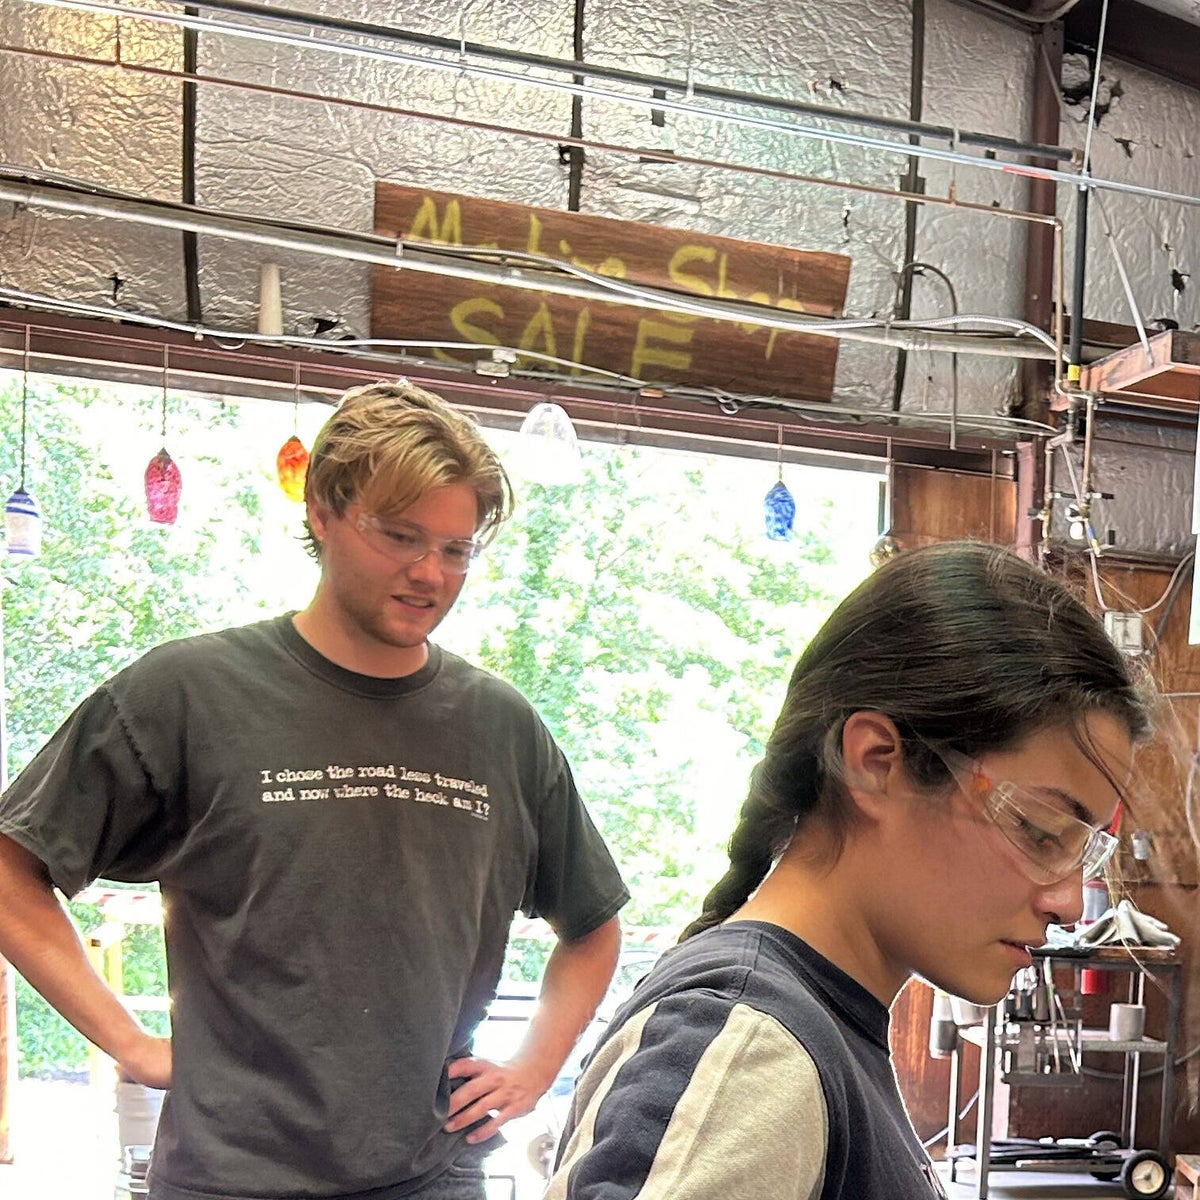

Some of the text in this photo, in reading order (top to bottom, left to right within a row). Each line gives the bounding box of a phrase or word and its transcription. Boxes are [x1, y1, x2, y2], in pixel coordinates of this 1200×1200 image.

[261, 765, 489, 798] I chose the road less traveled
[262, 783, 490, 816] and now where the heck am I?
